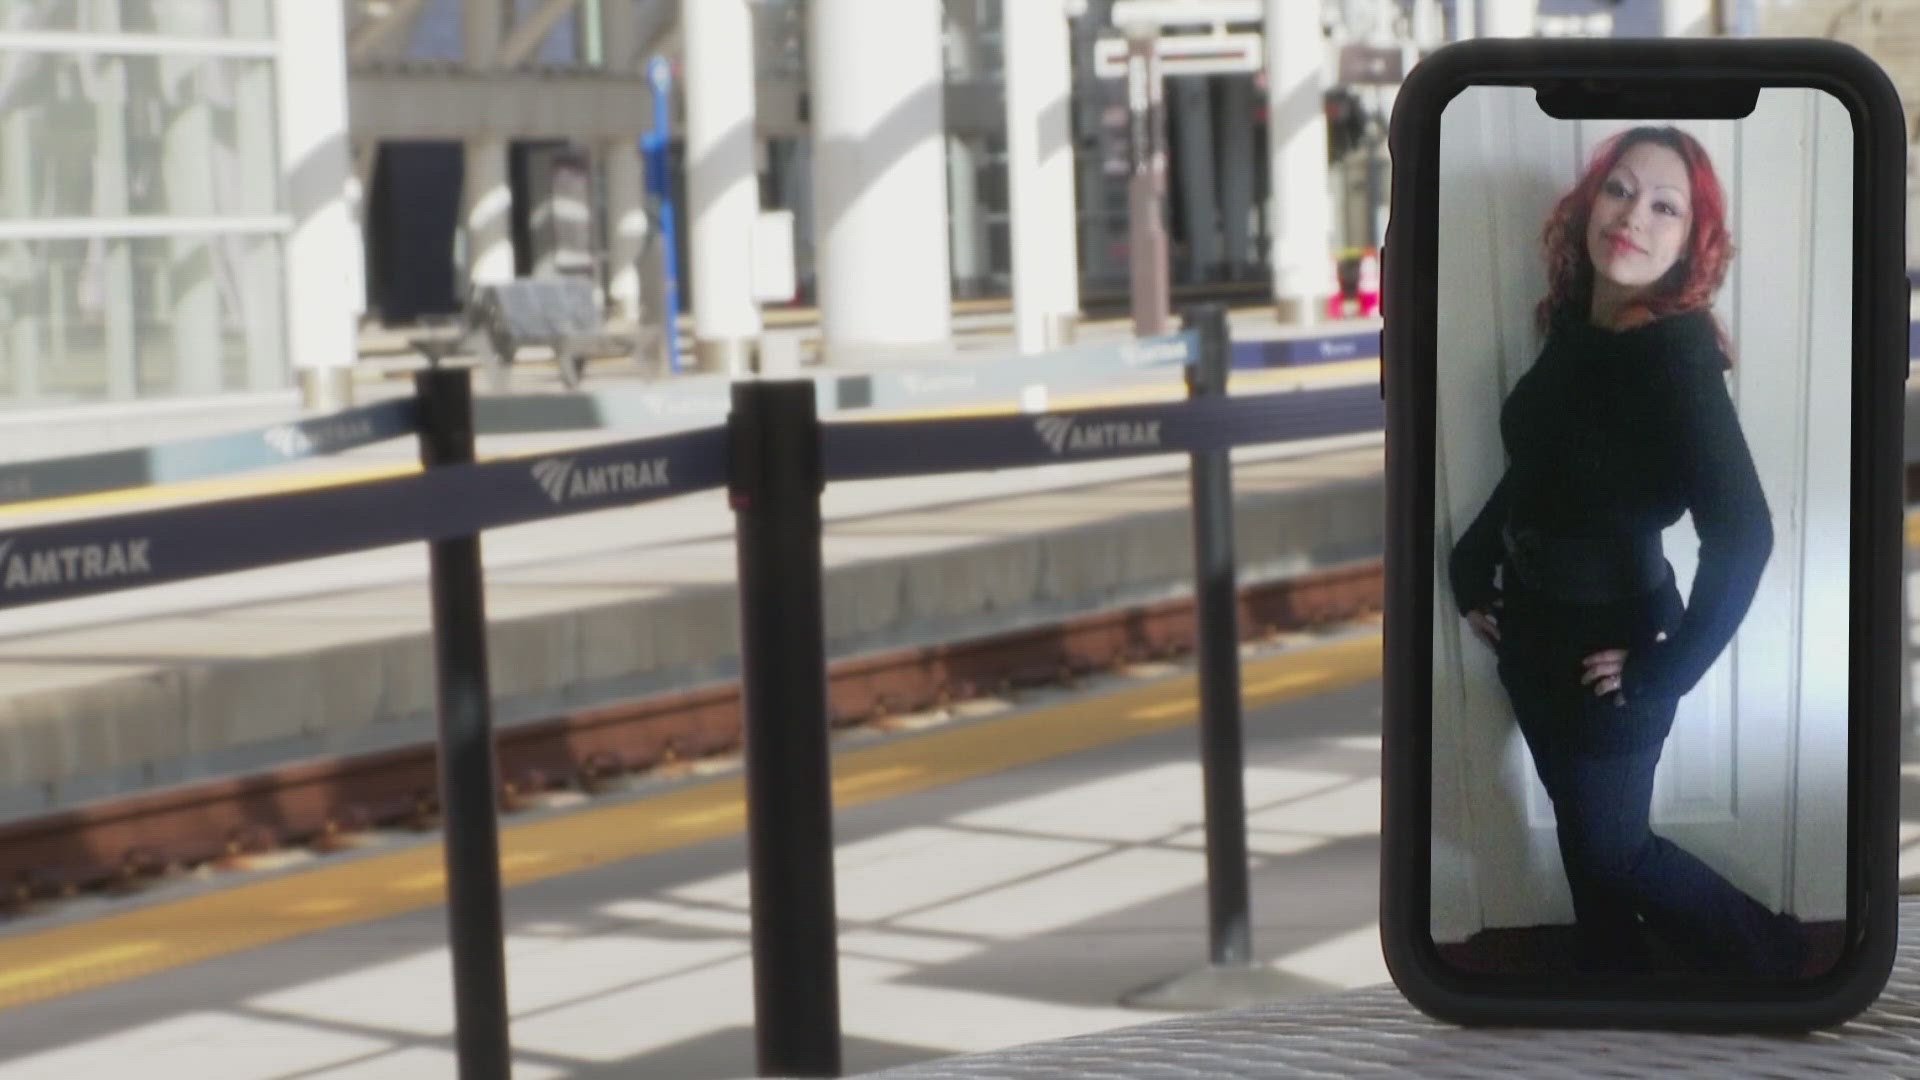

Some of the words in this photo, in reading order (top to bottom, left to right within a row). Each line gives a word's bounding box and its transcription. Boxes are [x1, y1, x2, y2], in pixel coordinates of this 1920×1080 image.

[1069, 421, 1161, 449] AMTRAK
[569, 457, 671, 498] AMTRAK
[4, 538, 151, 589] AMTRAK
